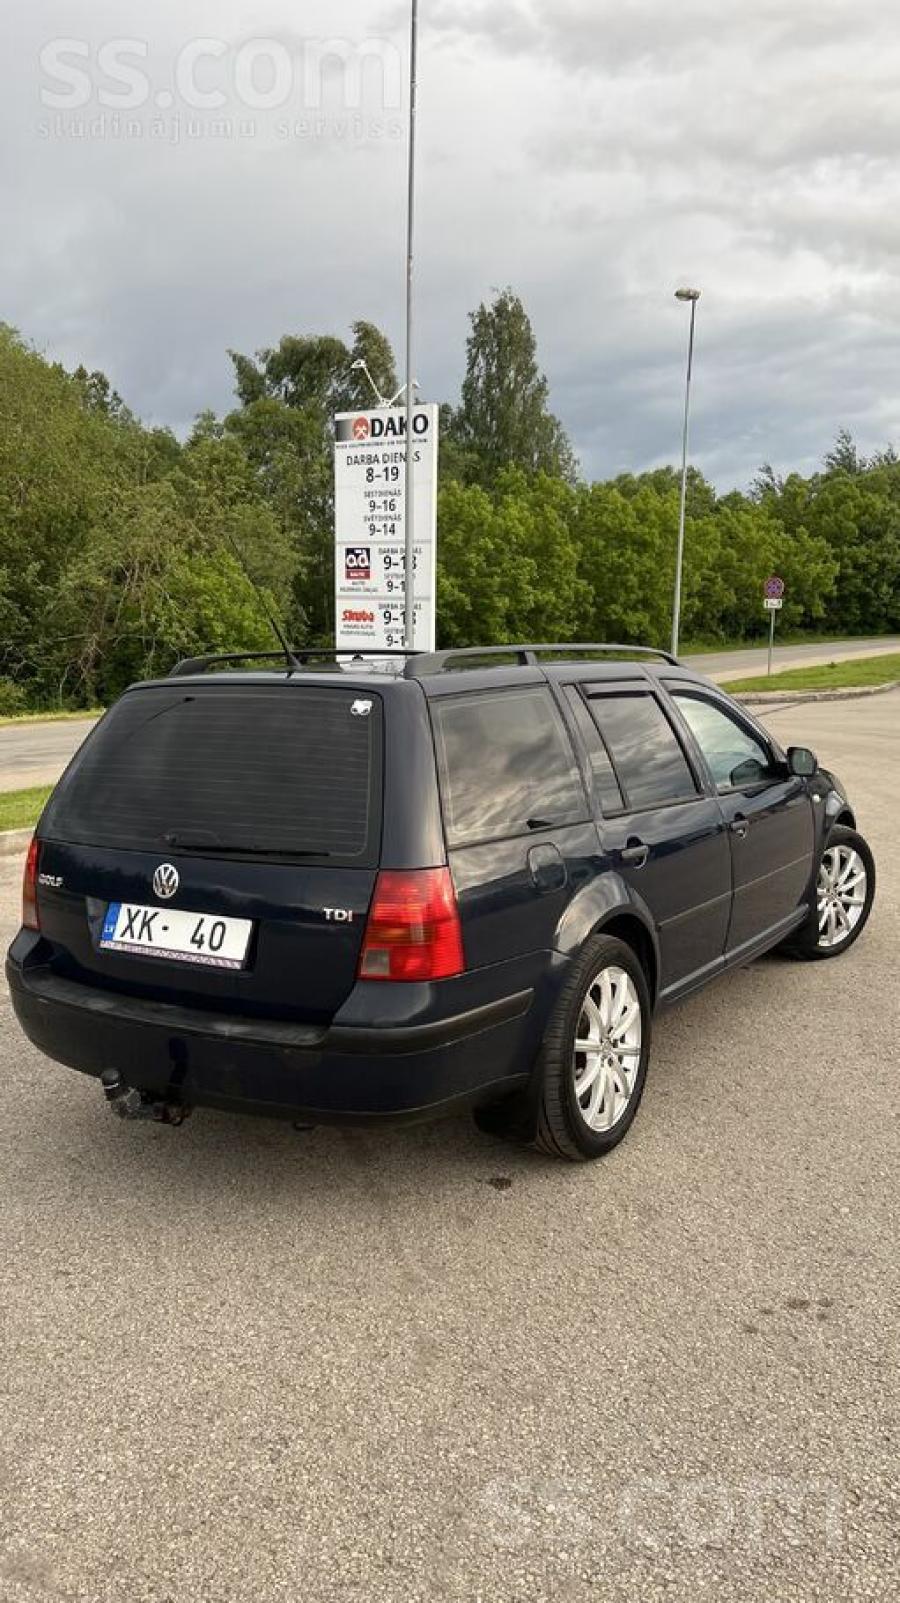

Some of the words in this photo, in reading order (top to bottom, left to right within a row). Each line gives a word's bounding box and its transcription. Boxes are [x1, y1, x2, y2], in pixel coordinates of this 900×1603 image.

[346, 453, 379, 465] DARBA
[382, 450, 421, 464] DIENS
[366, 466, 399, 483] 8-19
[369, 498, 397, 512] 9-16
[369, 523, 396, 536] 9-14
[322, 907, 354, 922] TDI
